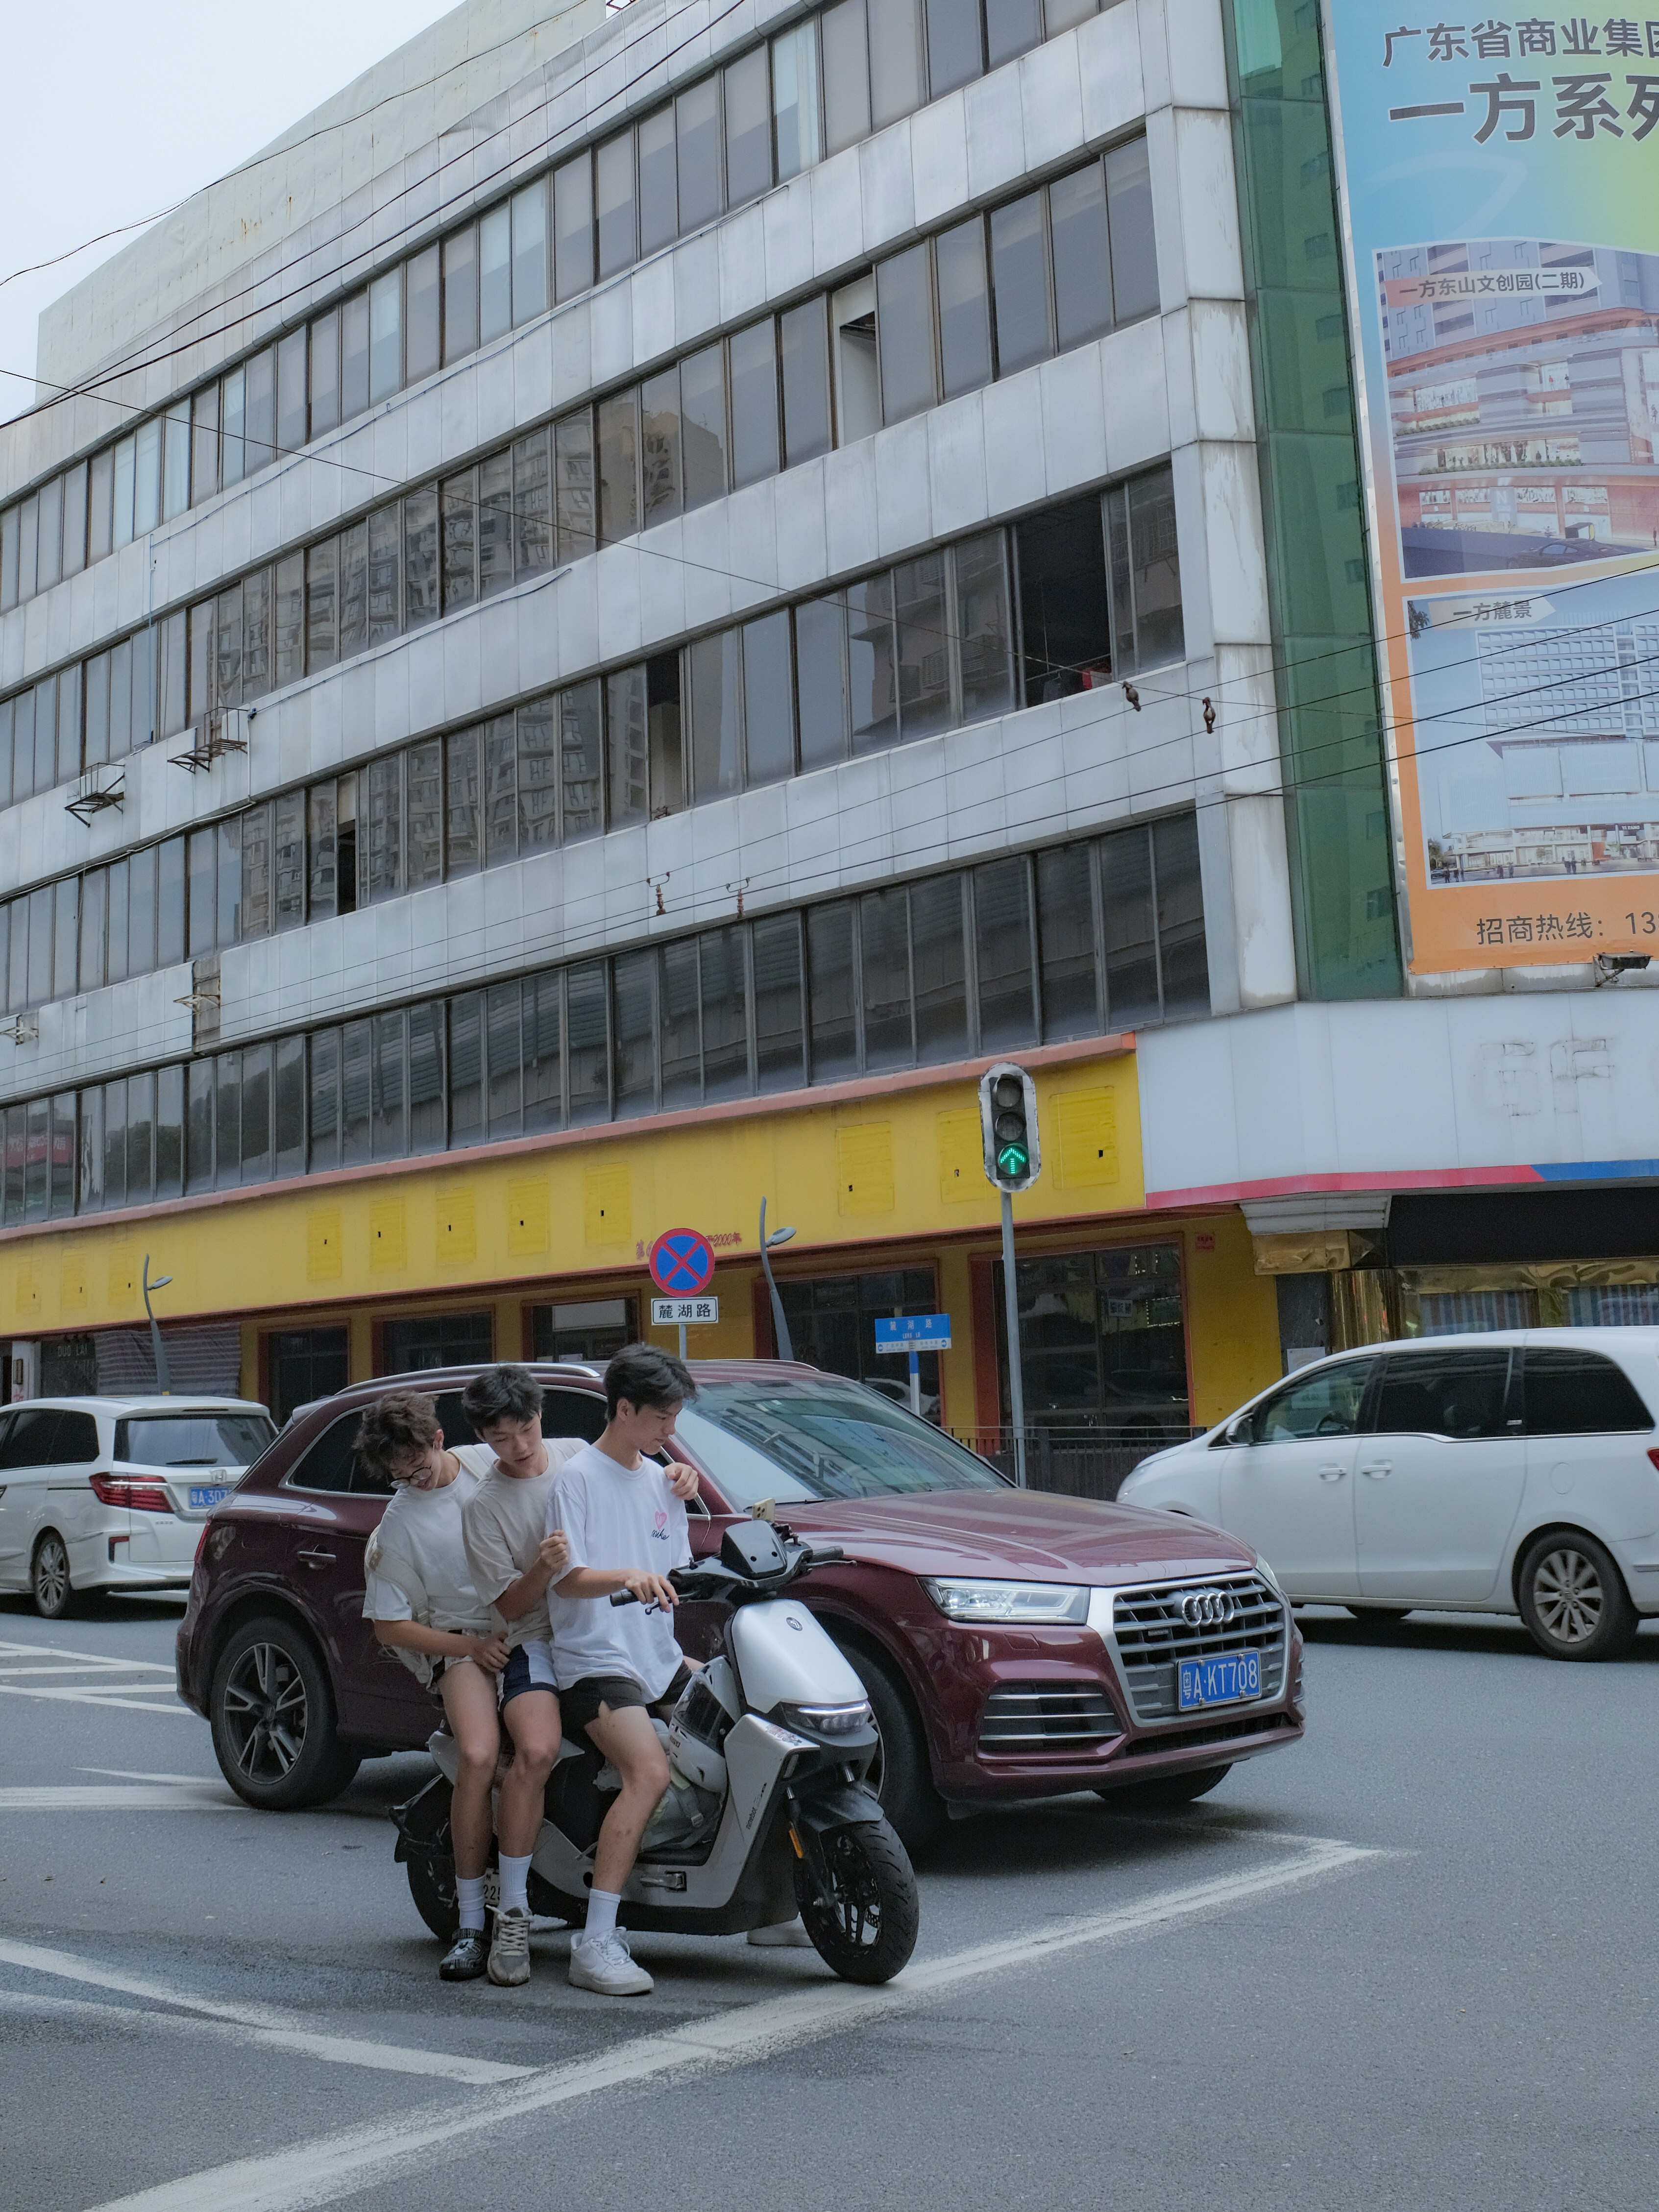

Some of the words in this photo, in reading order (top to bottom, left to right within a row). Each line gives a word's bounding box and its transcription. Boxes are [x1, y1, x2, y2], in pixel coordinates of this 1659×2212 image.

[1399, 271, 1585, 299] 一方东山文创园(二期)
[1453, 600, 1532, 621] 一方麓景
[1625, 911, 1659, 934] 13
[659, 1303, 711, 1319] 麓湖路
[890, 1318, 932, 1331] 麓湖路
